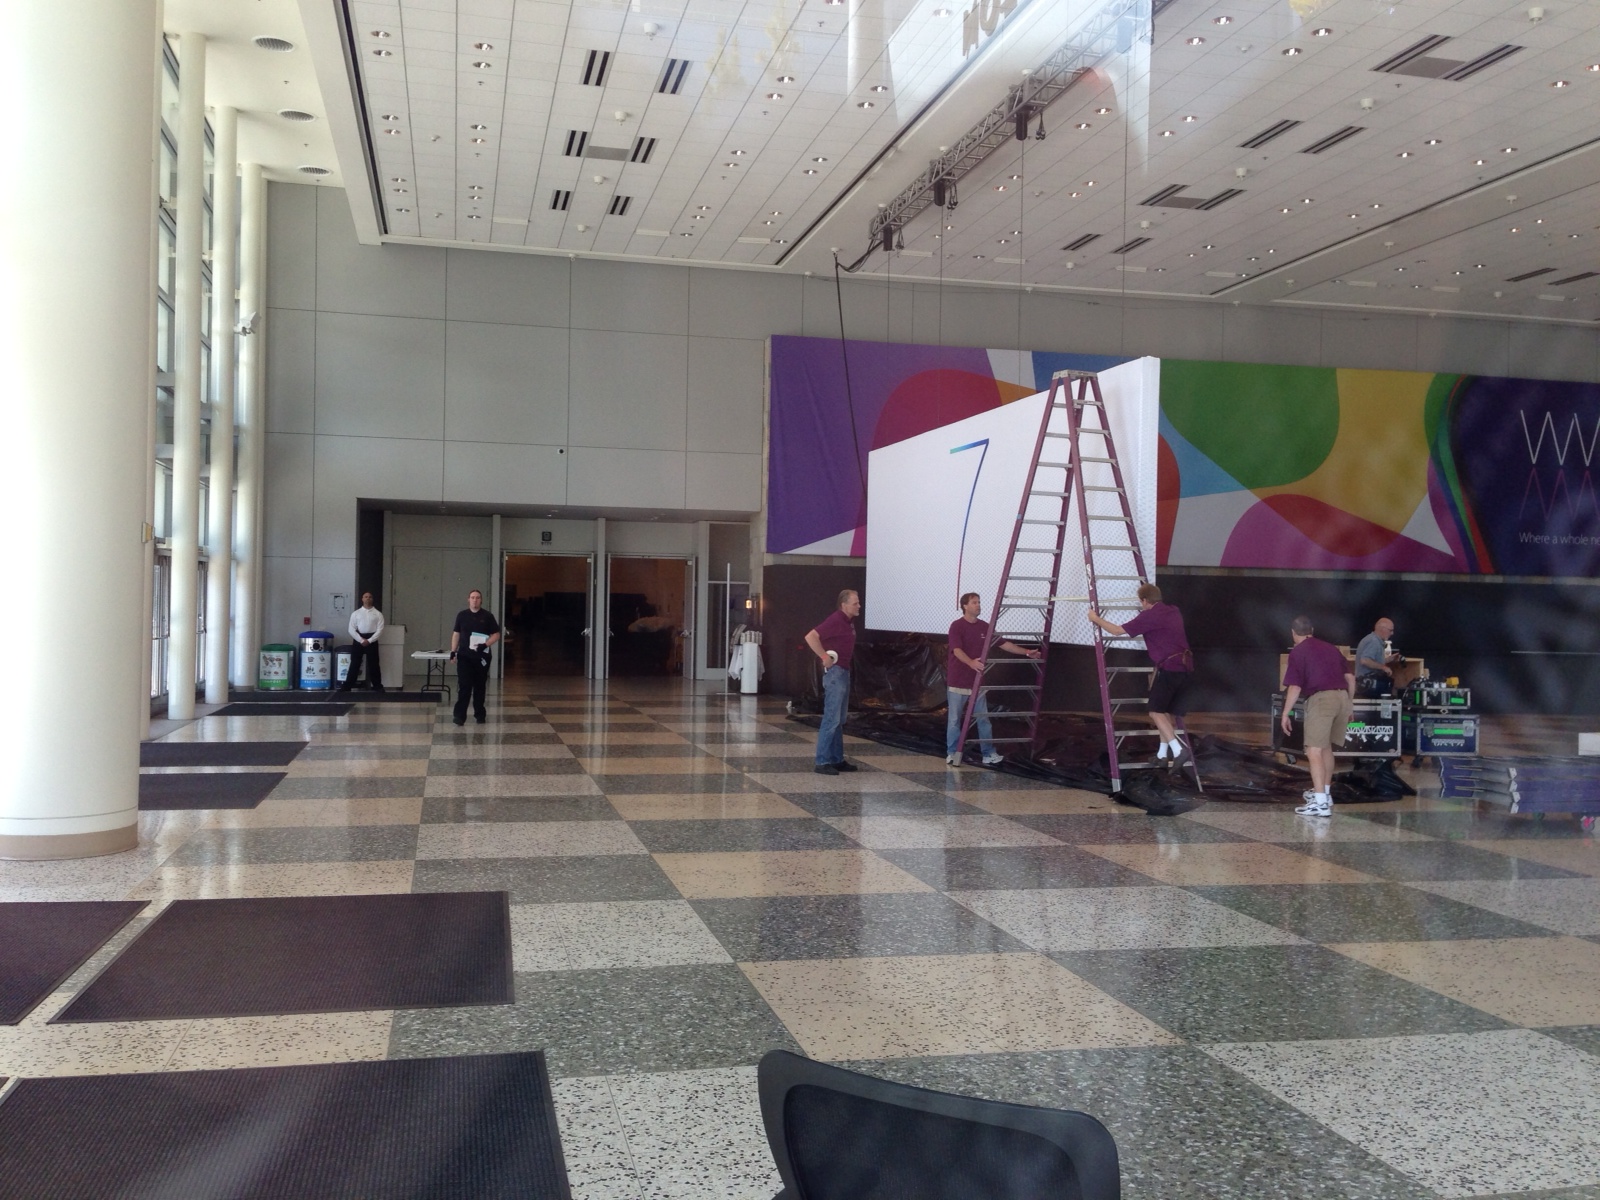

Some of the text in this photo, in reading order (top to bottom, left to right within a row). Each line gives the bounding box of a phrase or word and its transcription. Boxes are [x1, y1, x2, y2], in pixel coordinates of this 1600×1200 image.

[949, 438, 990, 611] 7
[1519, 531, 1550, 544] Where
[1552, 535, 1558, 544] a
[1560, 533, 1589, 546] whole
